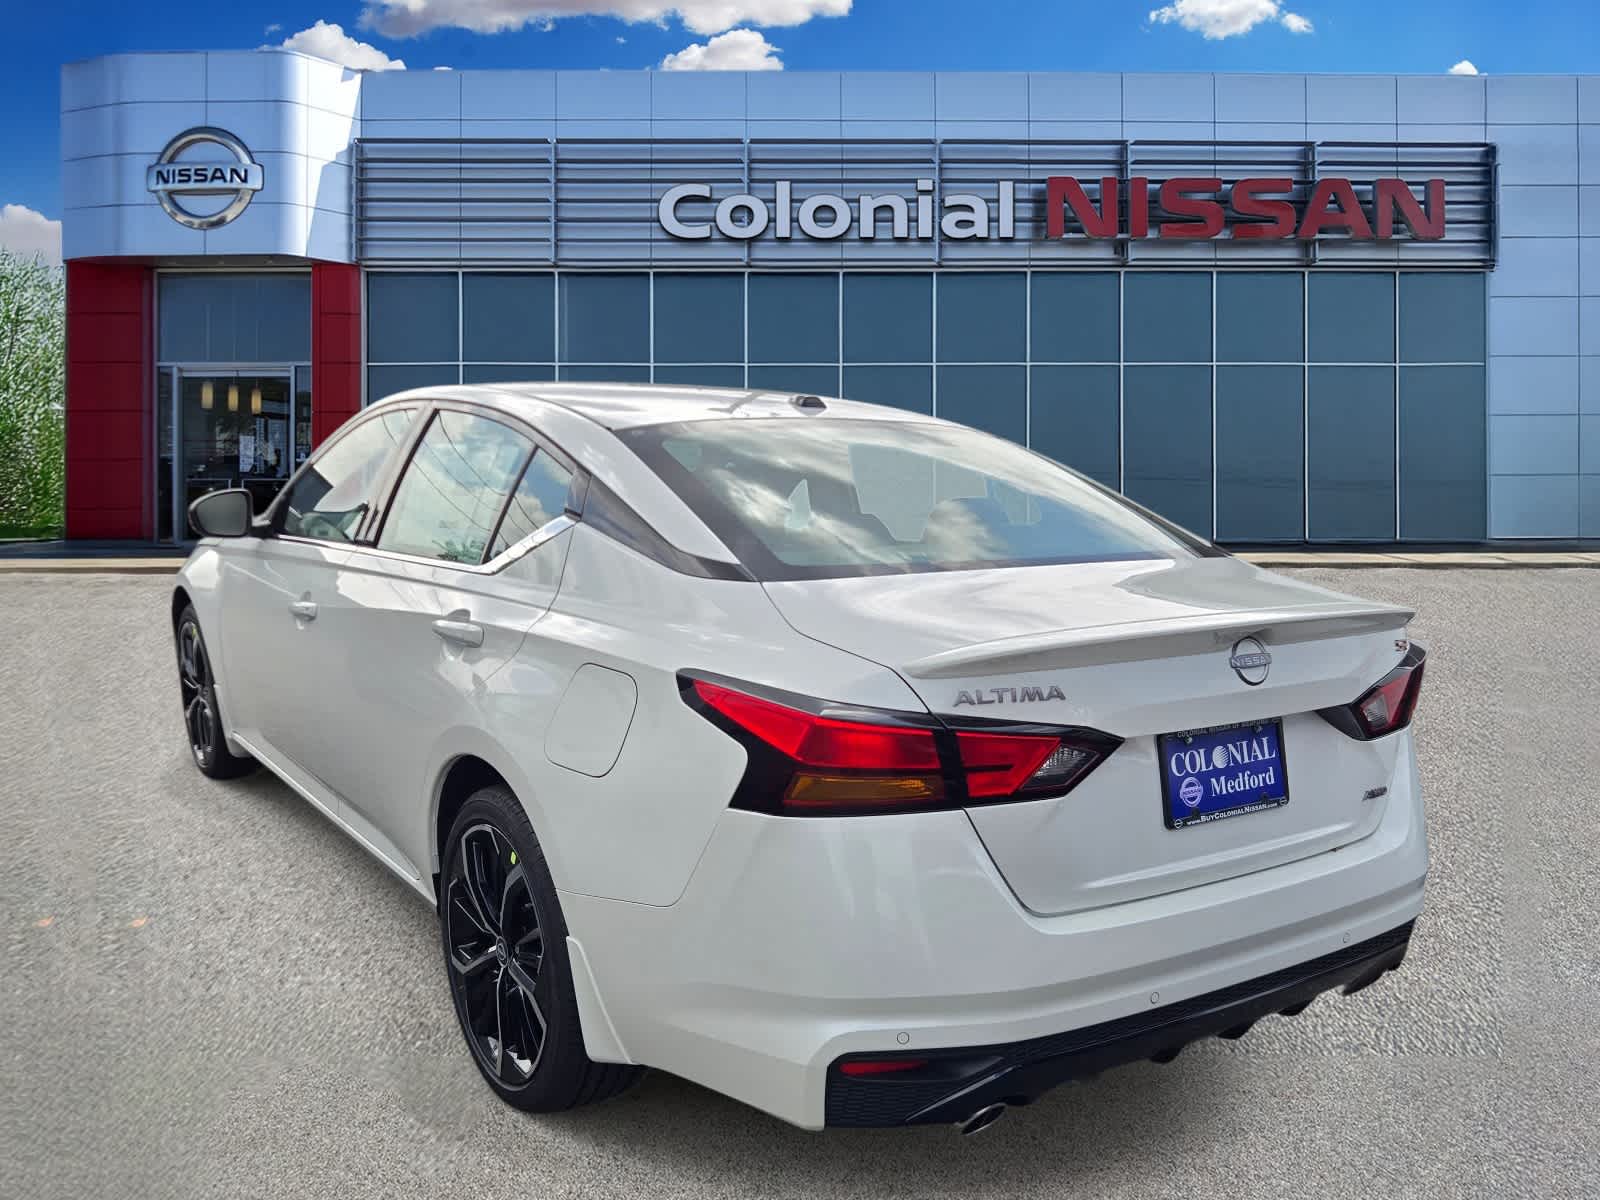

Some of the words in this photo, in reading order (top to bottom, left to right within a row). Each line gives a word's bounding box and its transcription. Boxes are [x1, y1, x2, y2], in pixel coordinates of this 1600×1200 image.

[155, 167, 249, 185] NISSAN
[658, 178, 1015, 240] Colonial
[1046, 176, 1446, 240] NISSAN
[952, 685, 1066, 707] ALTIMA
[1171, 737, 1276, 776] COLONIAL
[1211, 767, 1275, 796] Medford
